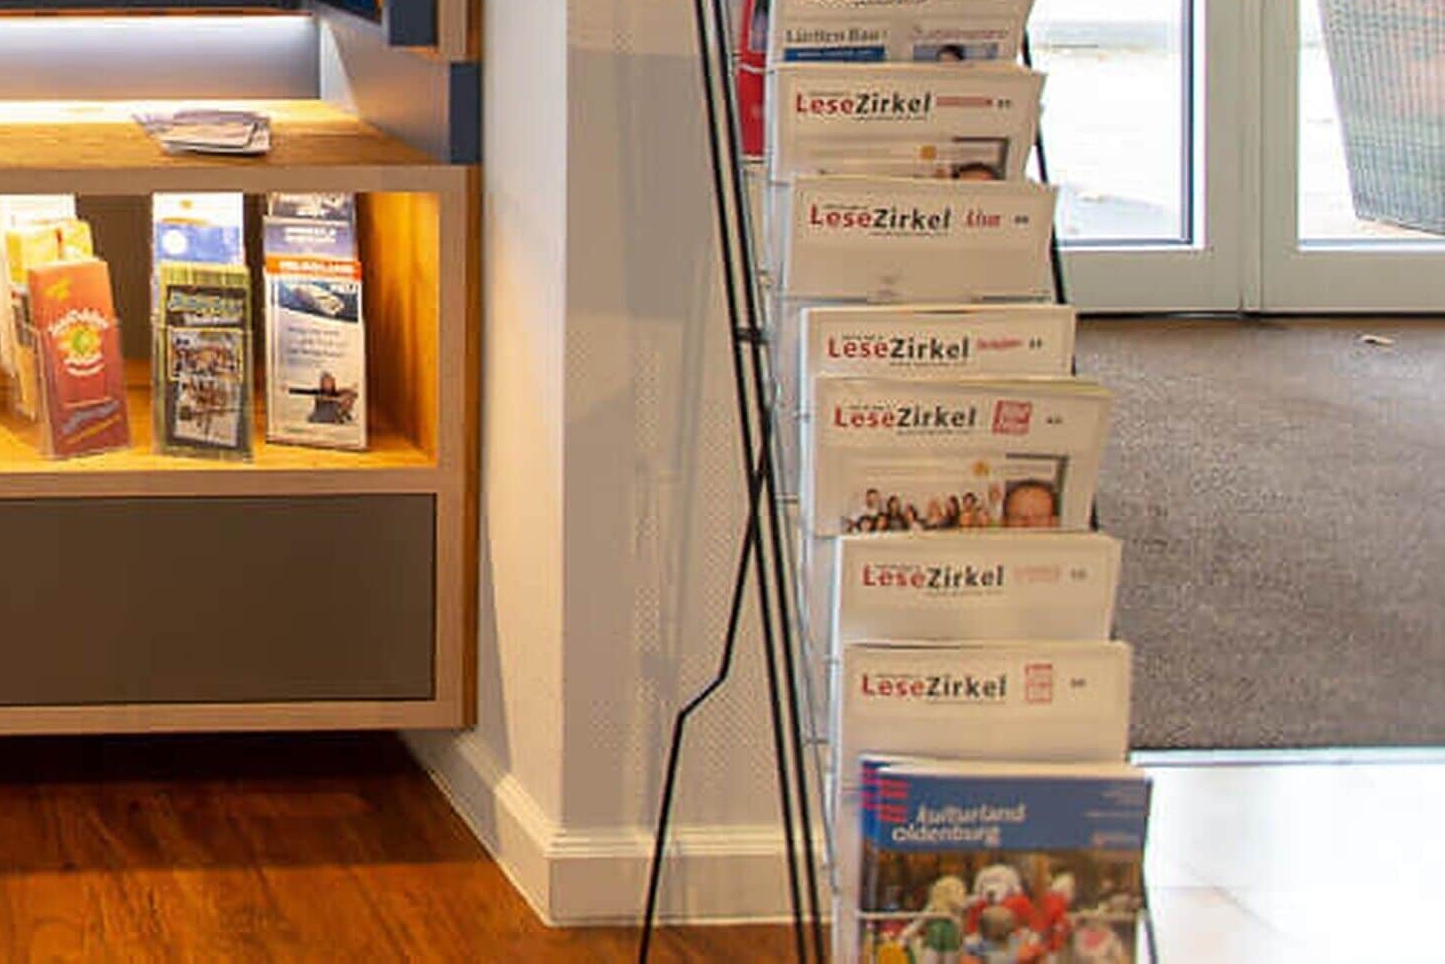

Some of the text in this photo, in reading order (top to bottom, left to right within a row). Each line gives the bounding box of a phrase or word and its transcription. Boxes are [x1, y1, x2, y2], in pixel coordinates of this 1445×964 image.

[795, 92, 933, 116] LeseZirkel
[810, 204, 952, 229] LeseZirkel
[827, 337, 970, 360] LeseZirkel
[833, 405, 977, 430] LeseZirkel
[862, 564, 1005, 590] LeseZirkel
[861, 673, 1008, 700] LeseZirkel
